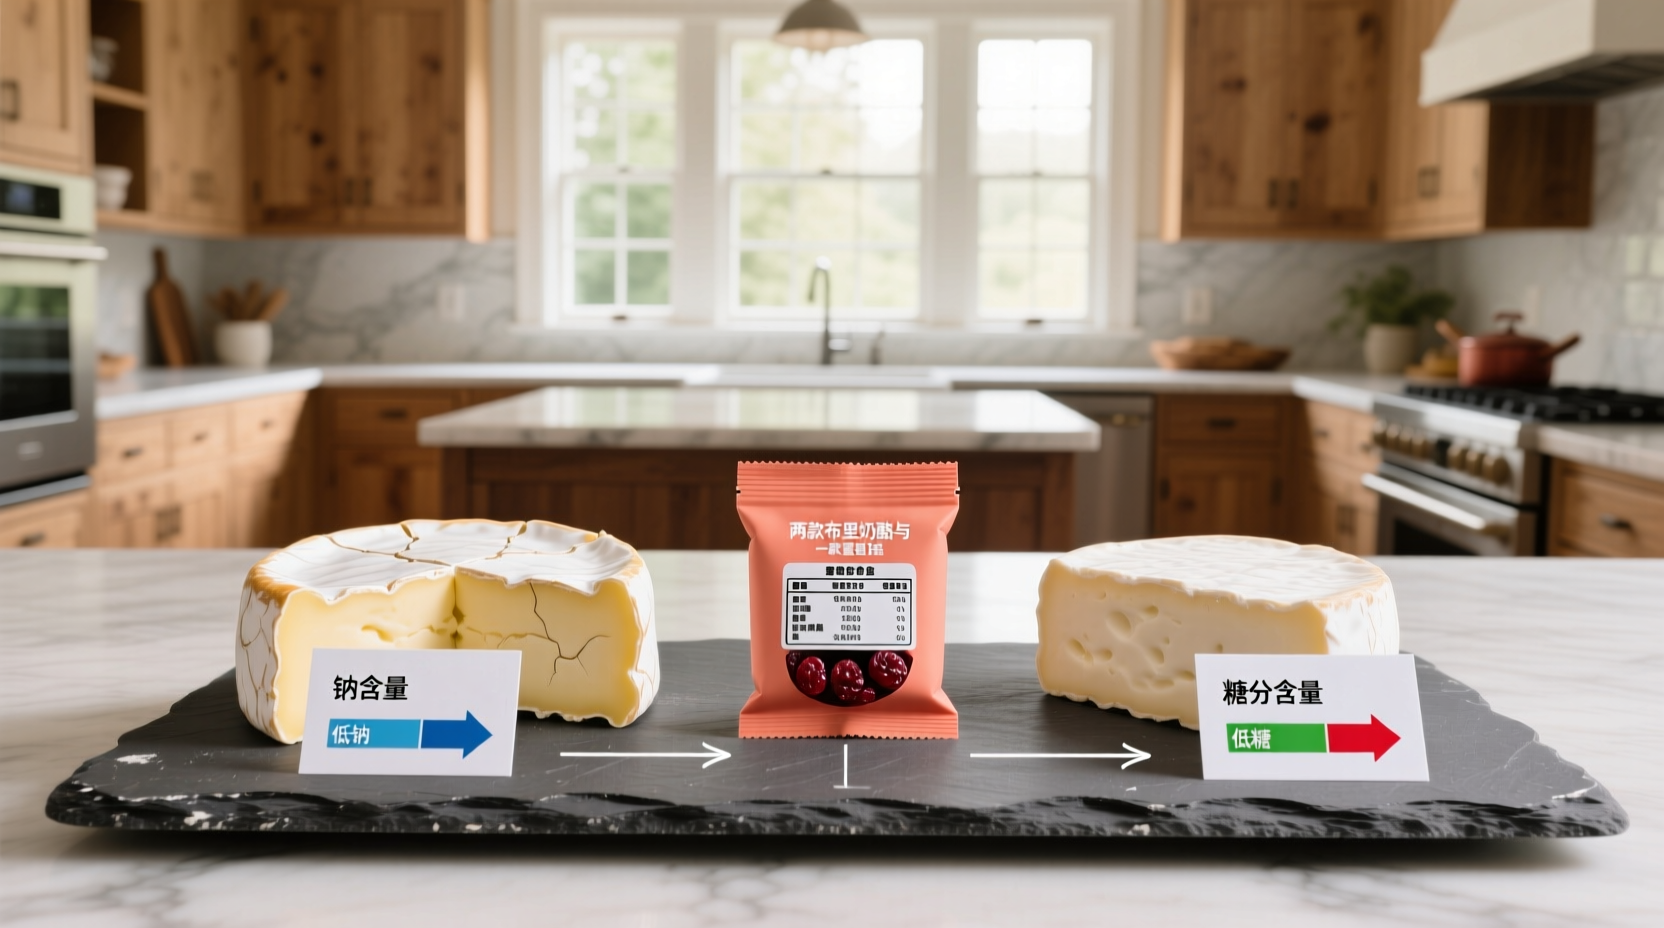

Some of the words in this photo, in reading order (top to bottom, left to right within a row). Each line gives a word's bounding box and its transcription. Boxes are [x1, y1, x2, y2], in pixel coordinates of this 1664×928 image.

[333, 674, 408, 701] 钠含量
[1222, 678, 1323, 706] 糖分含量
[331, 723, 370, 745] 低钠
[1231, 726, 1271, 750] 低糖
